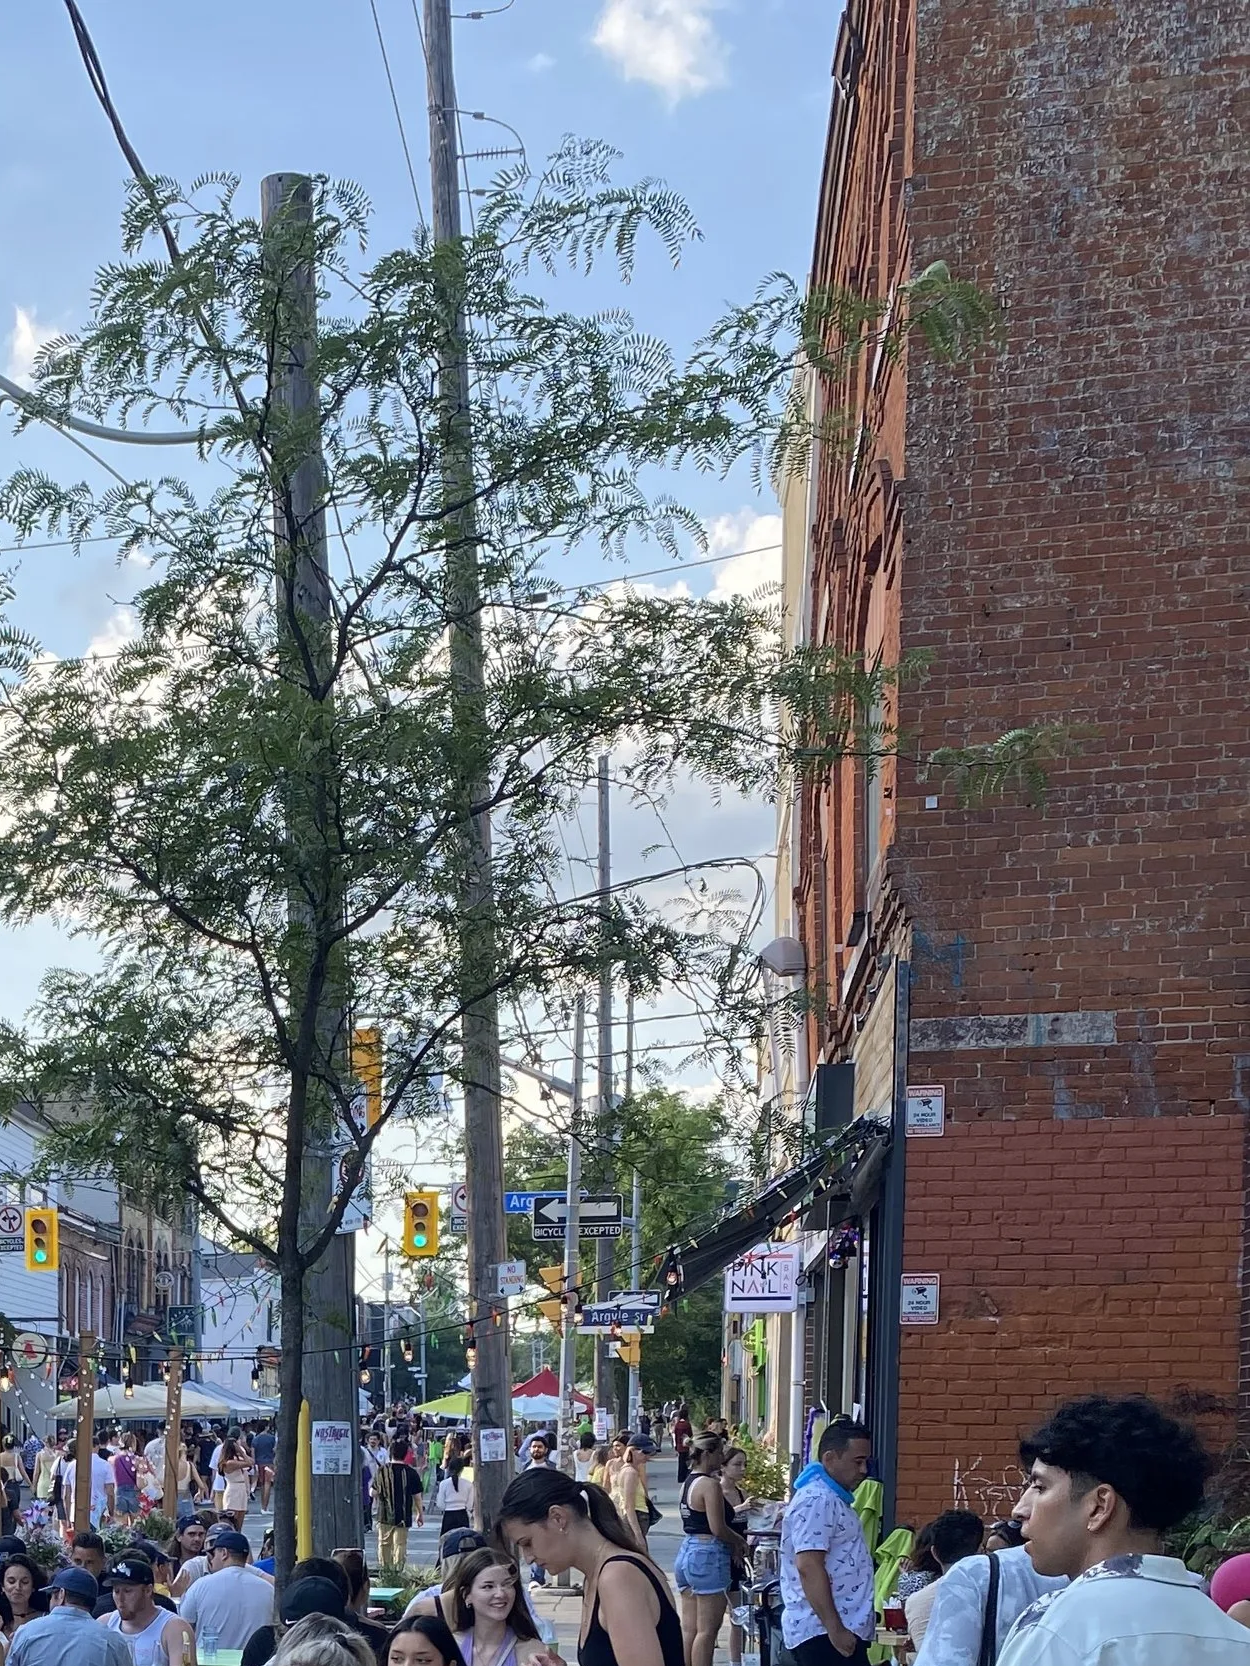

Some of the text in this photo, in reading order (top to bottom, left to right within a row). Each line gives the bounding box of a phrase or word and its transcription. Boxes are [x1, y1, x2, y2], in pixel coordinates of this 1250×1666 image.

[908, 1089, 942, 1097] WARNING
[534, 1226, 621, 1237] BICYCL EXCEPTED
[507, 1265, 516, 1274] NO
[732, 1260, 778, 1277] PINK
[500, 1277, 524, 1285] STANDING
[903, 1277, 937, 1285] WARNING
[732, 1280, 778, 1294] NAIL
[591, 1310, 629, 1324] Argyle
